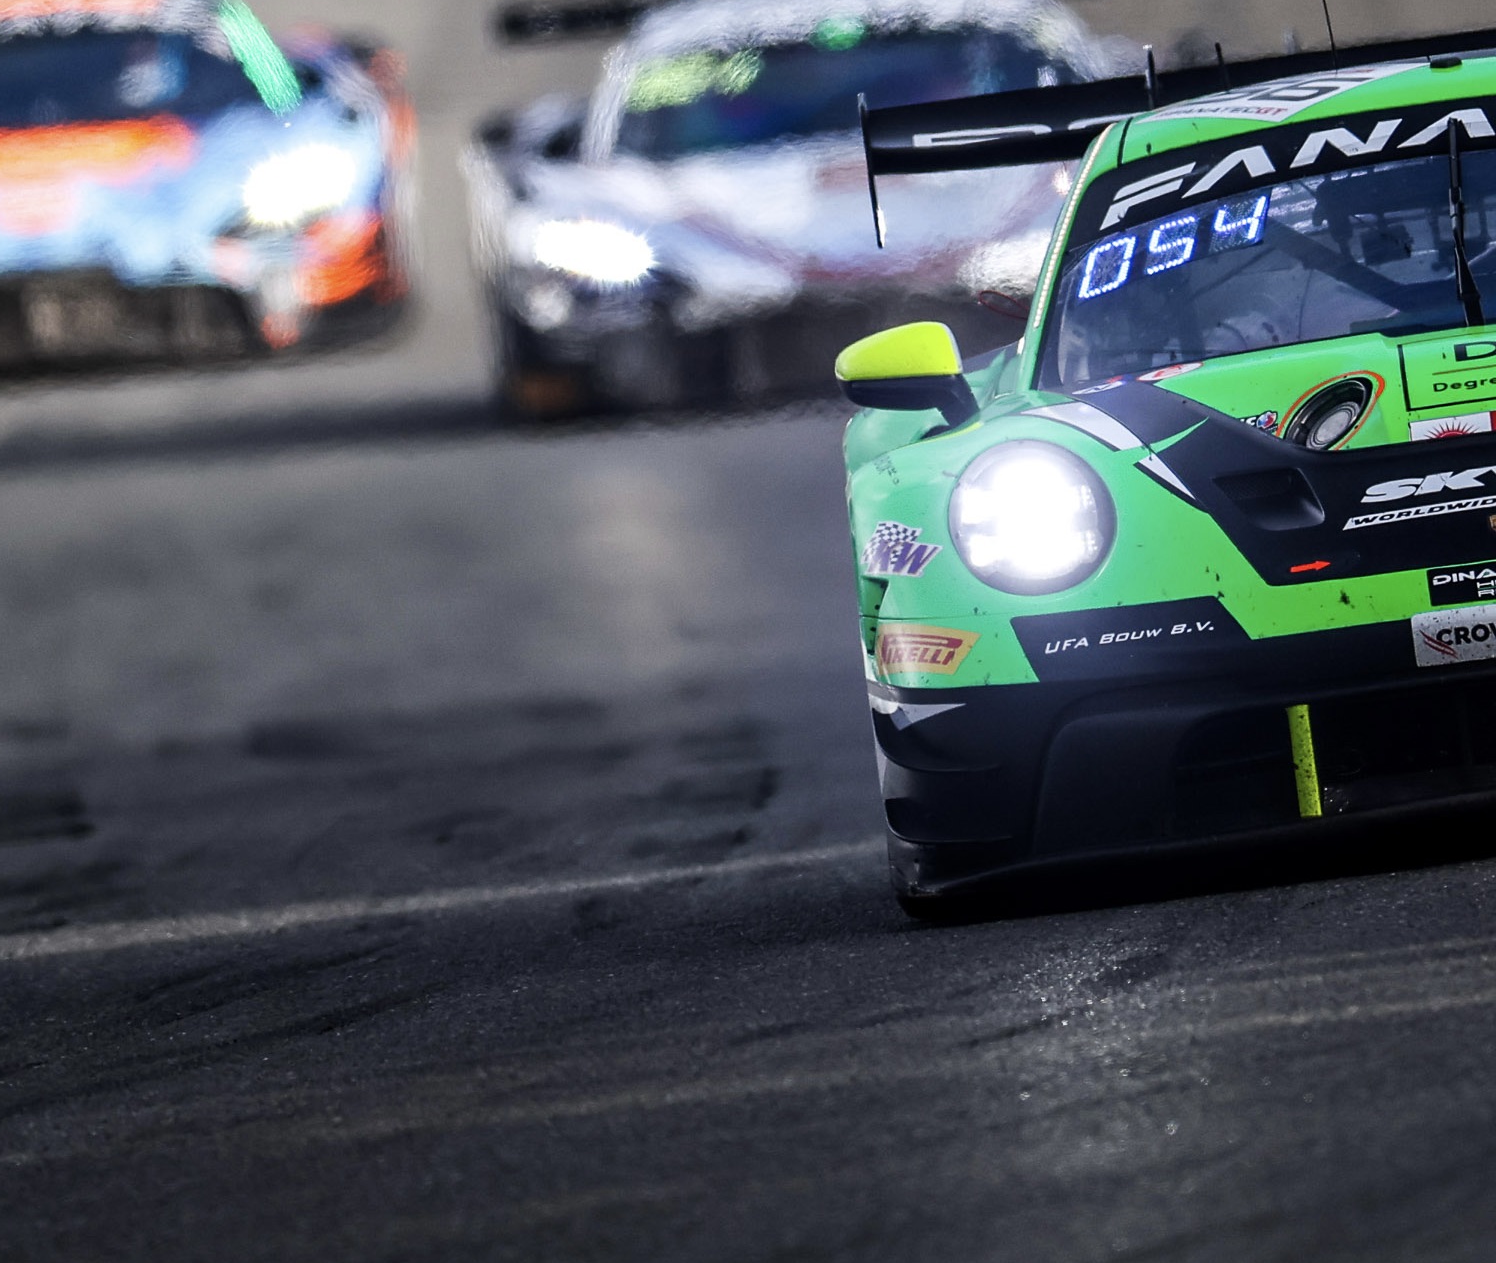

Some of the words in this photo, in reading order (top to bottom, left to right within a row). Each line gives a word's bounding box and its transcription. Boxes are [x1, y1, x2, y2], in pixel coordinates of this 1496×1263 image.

[1078, 194, 1269, 301] 054
[880, 633, 964, 666] PIRELLI
[1044, 637, 1089, 655] UFA
[1170, 621, 1215, 635] B.V.
